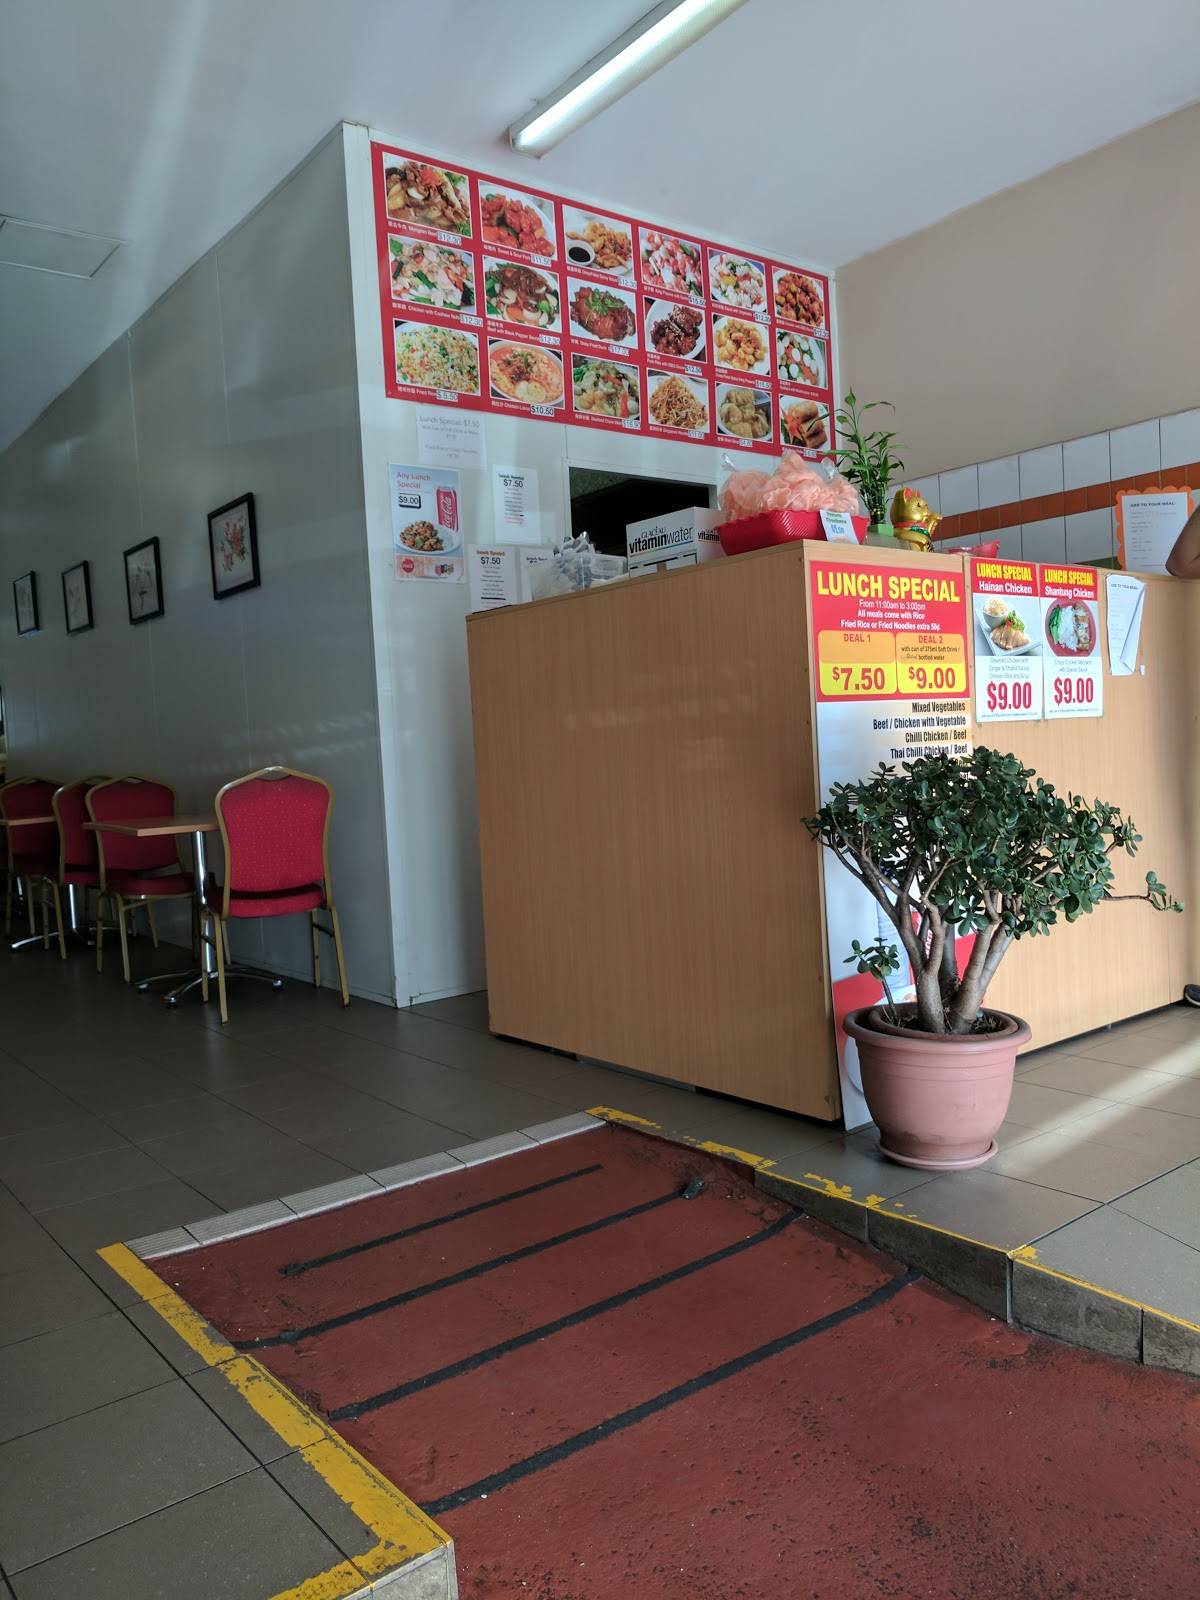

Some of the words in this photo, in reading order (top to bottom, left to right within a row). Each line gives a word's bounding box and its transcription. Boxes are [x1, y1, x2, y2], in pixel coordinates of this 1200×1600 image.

[531, 405, 554, 416] $10.50
[396, 472, 410, 480] Any
[412, 473, 432, 481] Lunch
[504, 478, 524, 488] $7.50
[397, 480, 421, 490] Special
[398, 495, 419, 505] $9.00
[629, 526, 694, 554] vitaminwater
[480, 556, 501, 565] $7.50
[976, 562, 1002, 579] LUNCH
[1003, 566, 1032, 581] SPECIAL
[1044, 569, 1068, 584] LUNCH
[1068, 572, 1094, 586] SPECIAL
[817, 571, 883, 598] LUNCH
[888, 576, 960, 602] SPECIAL
[979, 581, 1004, 592] Hainan
[1004, 583, 1032, 594] Chicken
[1045, 586, 1072, 599] Shantung
[1073, 588, 1094, 598] Chicken
[860, 600, 874, 608] From
[876, 600, 898, 610] 11:00am
[900, 602, 906, 610] to
[912, 612, 925, 620] Rice
[841, 620, 856, 628] Fried
[858, 620, 870, 628] Rice
[878, 621, 892, 629] Fried
[894, 622, 916, 630] Noodles
[844, 634, 865, 642] DEAL
[866, 634, 871, 643] 1
[918, 635, 938, 644] DEAL
[939, 636, 944, 644] 2
[832, 666, 886, 690] $7.50
[908, 666, 956, 690] $9.00
[987, 681, 1032, 712] $9.00
[1054, 676, 1094, 706] $9.00
[912, 702, 930, 713] Mixed
[932, 702, 966, 713] Vegetables
[873, 718, 888, 730] Beef
[890, 719, 893, 730] /
[894, 717, 920, 728] Chicken
[922, 716, 934, 727] with
[936, 715, 966, 728] Vegetable
[905, 732, 922, 743] Chilli
[924, 730, 948, 742] Chicken
[950, 730, 952, 740] /
[954, 730, 966, 740] Beef
[891, 748, 904, 759] Thai
[906, 746, 922, 758] Chilli
[924, 744, 949, 756] Chicken
[950, 744, 953, 755] /
[954, 743, 968, 754] Beef
